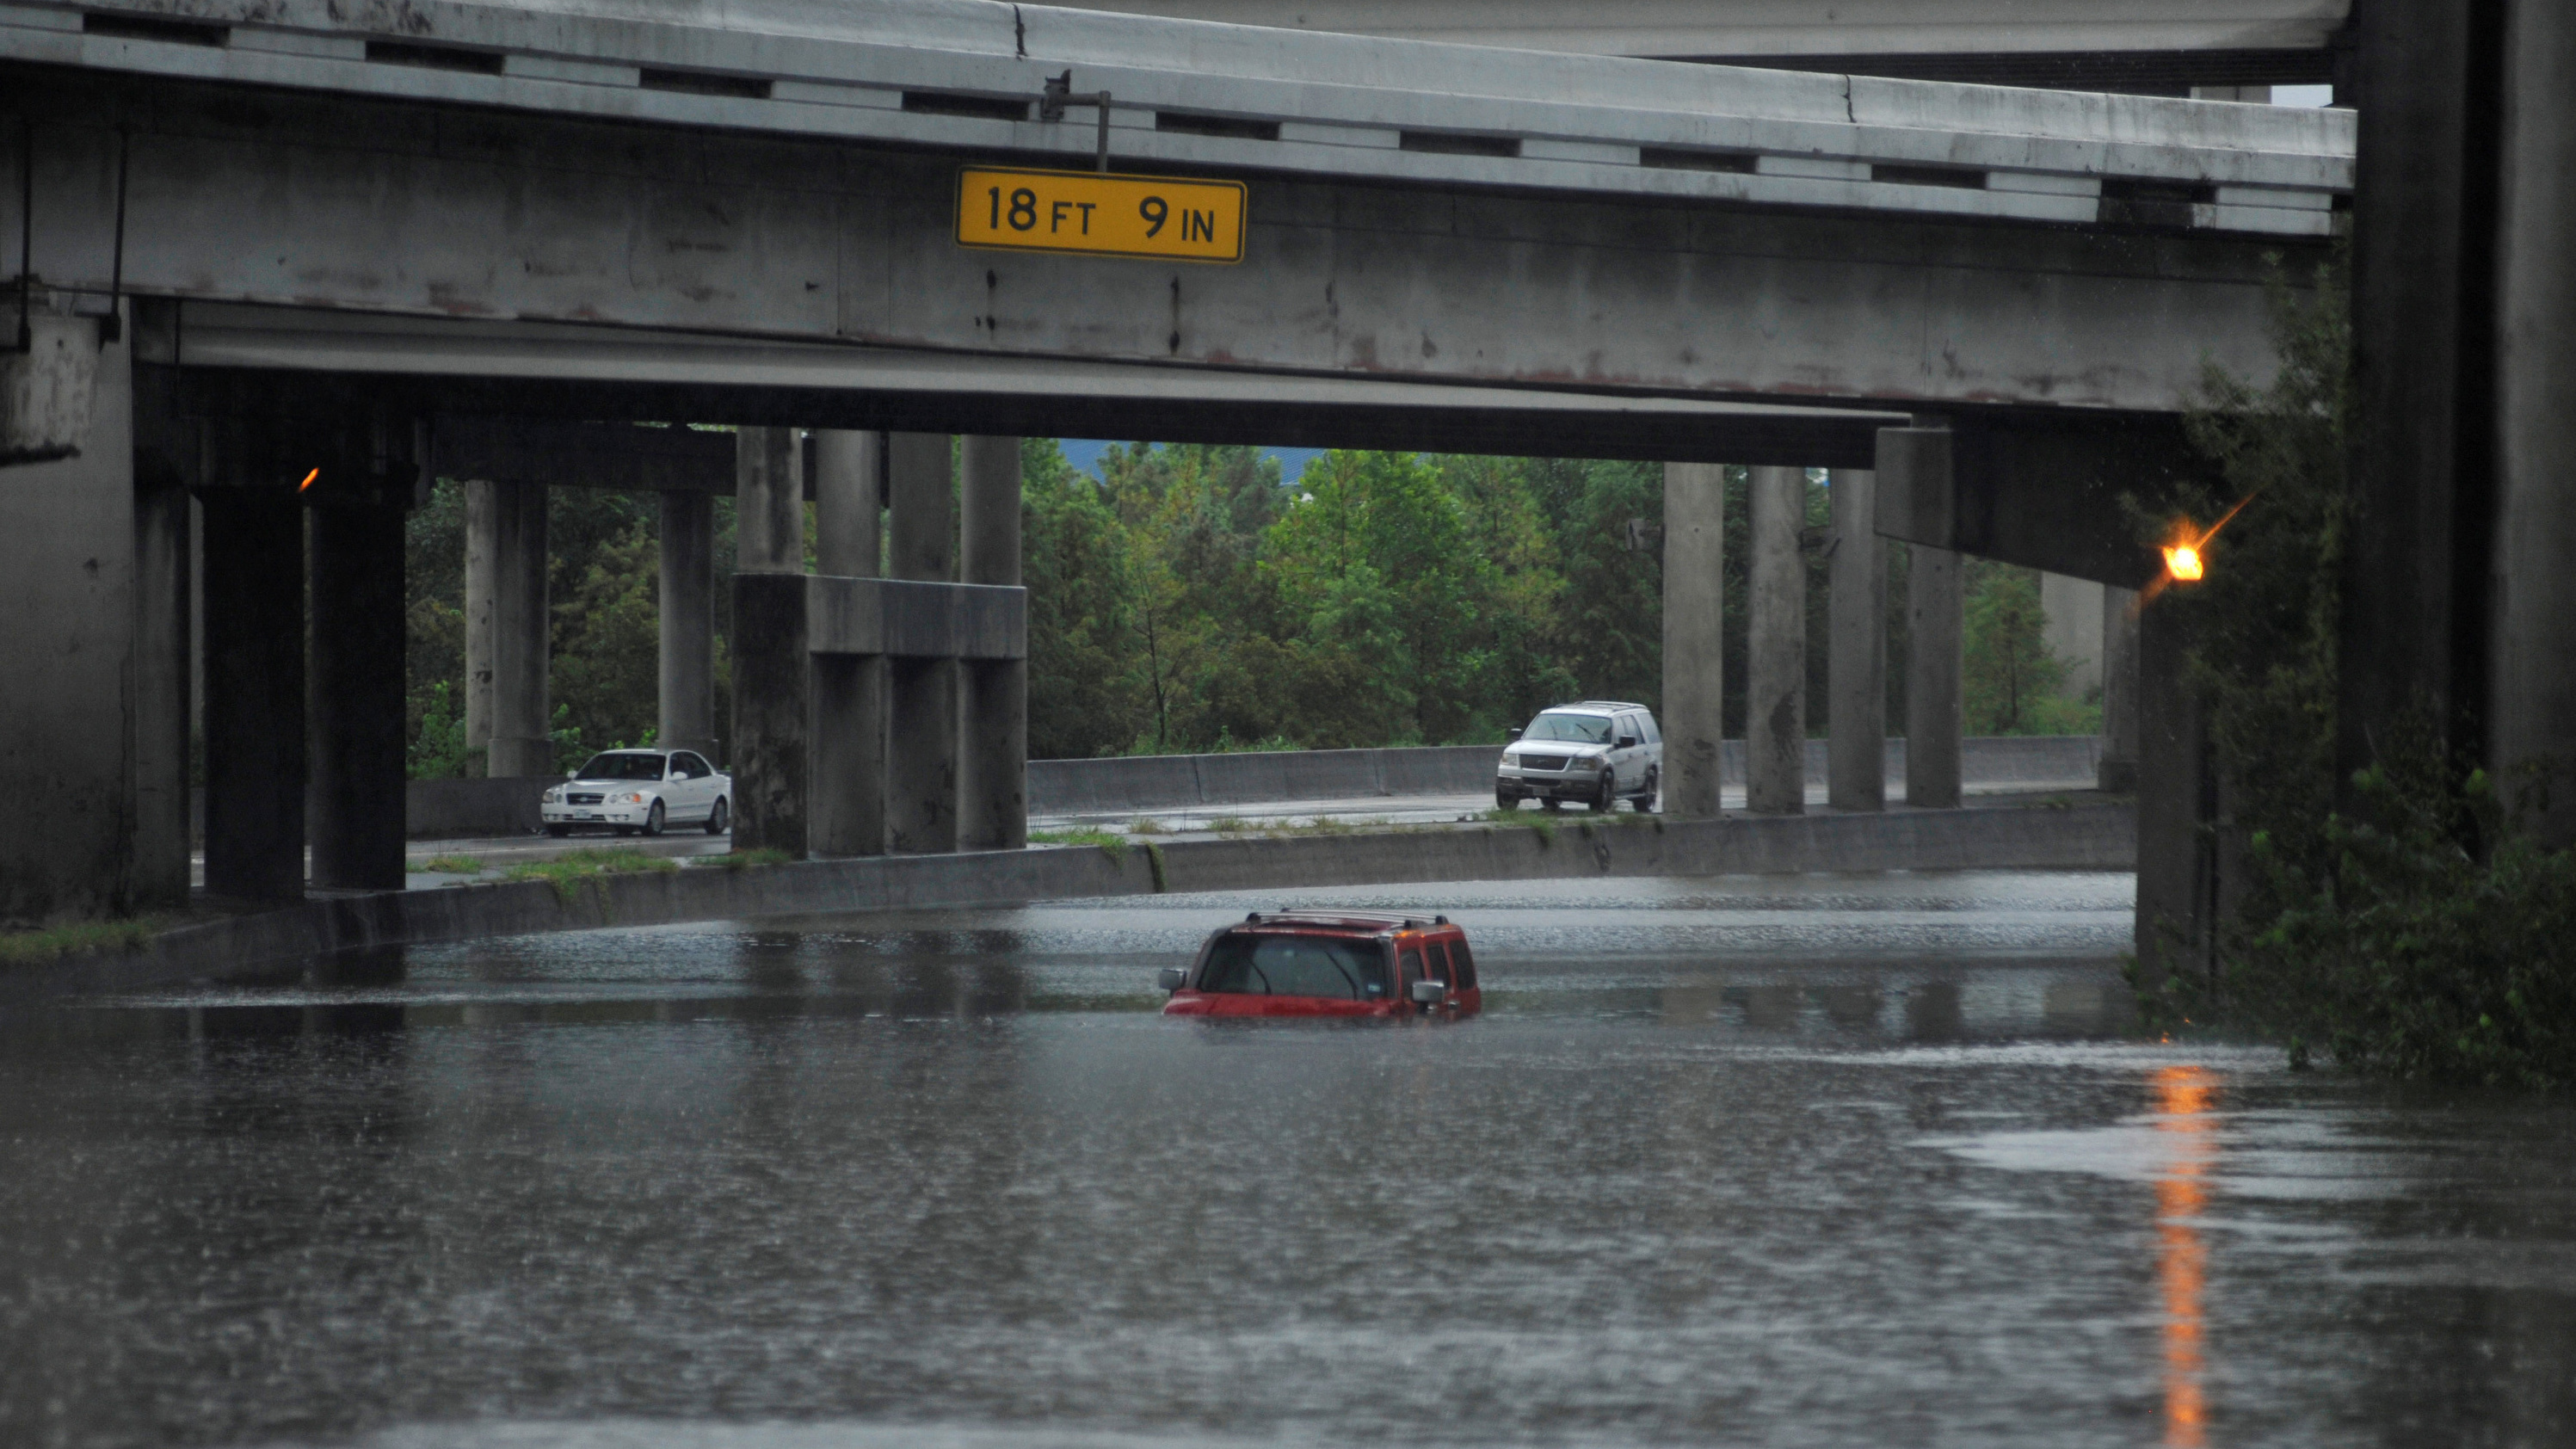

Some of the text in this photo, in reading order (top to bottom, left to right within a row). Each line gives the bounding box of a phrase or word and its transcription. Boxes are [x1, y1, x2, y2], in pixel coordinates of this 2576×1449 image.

[989, 187, 1214, 243] 18 FT 9 IN
